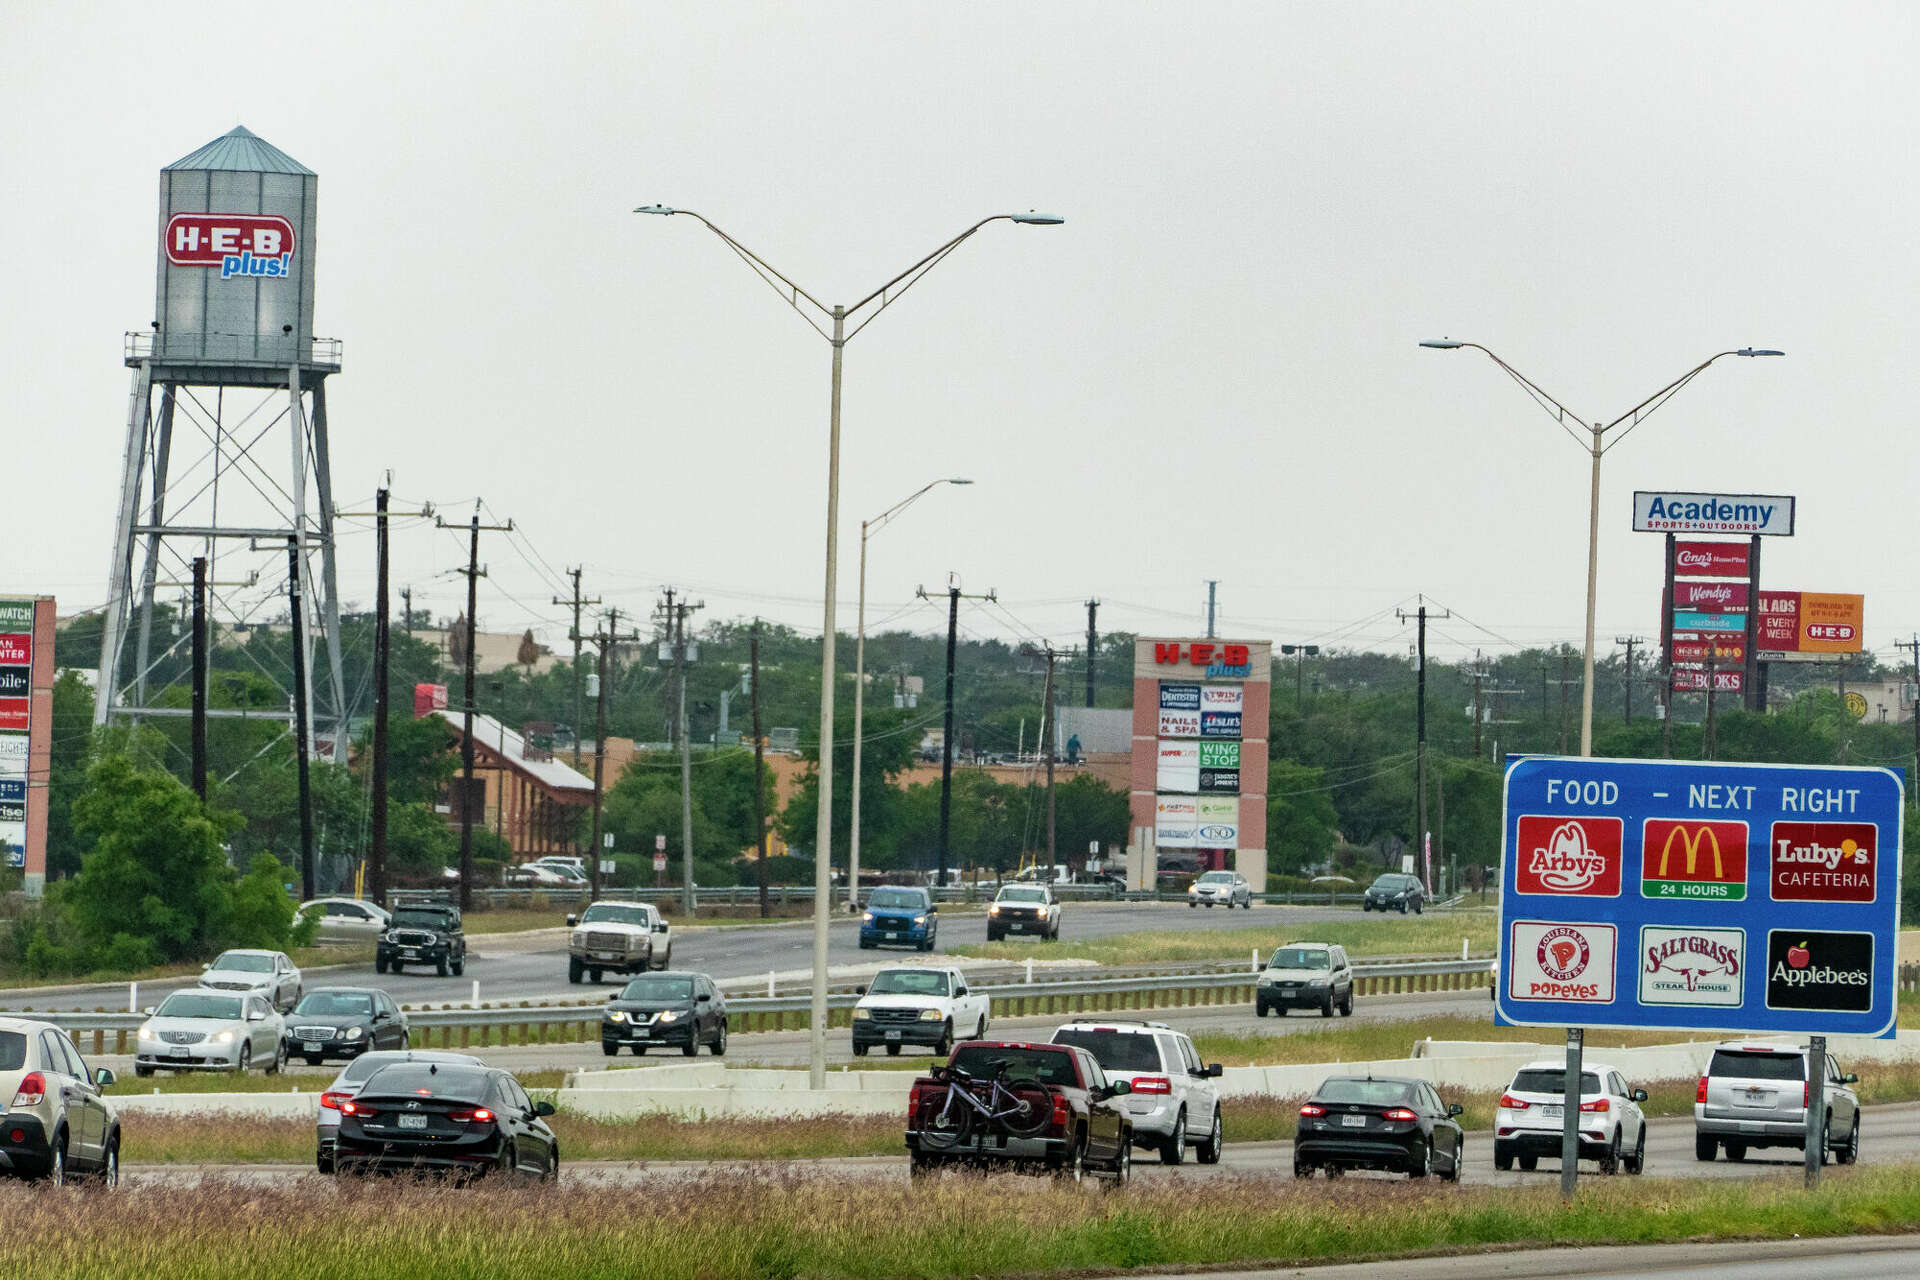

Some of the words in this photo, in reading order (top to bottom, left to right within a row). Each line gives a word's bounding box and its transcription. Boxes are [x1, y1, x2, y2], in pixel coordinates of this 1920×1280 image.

[222, 251, 290, 279] plus!
[1648, 496, 1774, 528] Academy
[1677, 550, 1712, 567] Conn's
[1689, 585, 1732, 603] Wendy's
[1771, 599, 1796, 613] ADS
[1767, 618, 1796, 628] EVERY
[1767, 628, 1792, 639] WEEK
[1205, 663, 1252, 679] plus!
[1161, 716, 1198, 726] NAILS
[1161, 725, 1170, 733] &
[1174, 726, 1198, 735] SPA
[1202, 743, 1239, 755] WING
[1202, 754, 1239, 766] STOP
[1547, 779, 1619, 806] FOOD
[1689, 784, 1757, 810] NEXT
[1781, 787, 1861, 813] RIGHT
[1776, 839, 1868, 870] Luby's
[1532, 850, 1604, 877] Arby's
[1778, 871, 1870, 888] CAFETERIA
[1660, 884, 1676, 895] 24
[1682, 885, 1728, 897] HOURS
[1539, 928, 1588, 952] LOUISIANA
[1645, 936, 1739, 976] SALTGRASS
[1771, 960, 1868, 987] Applebee's
